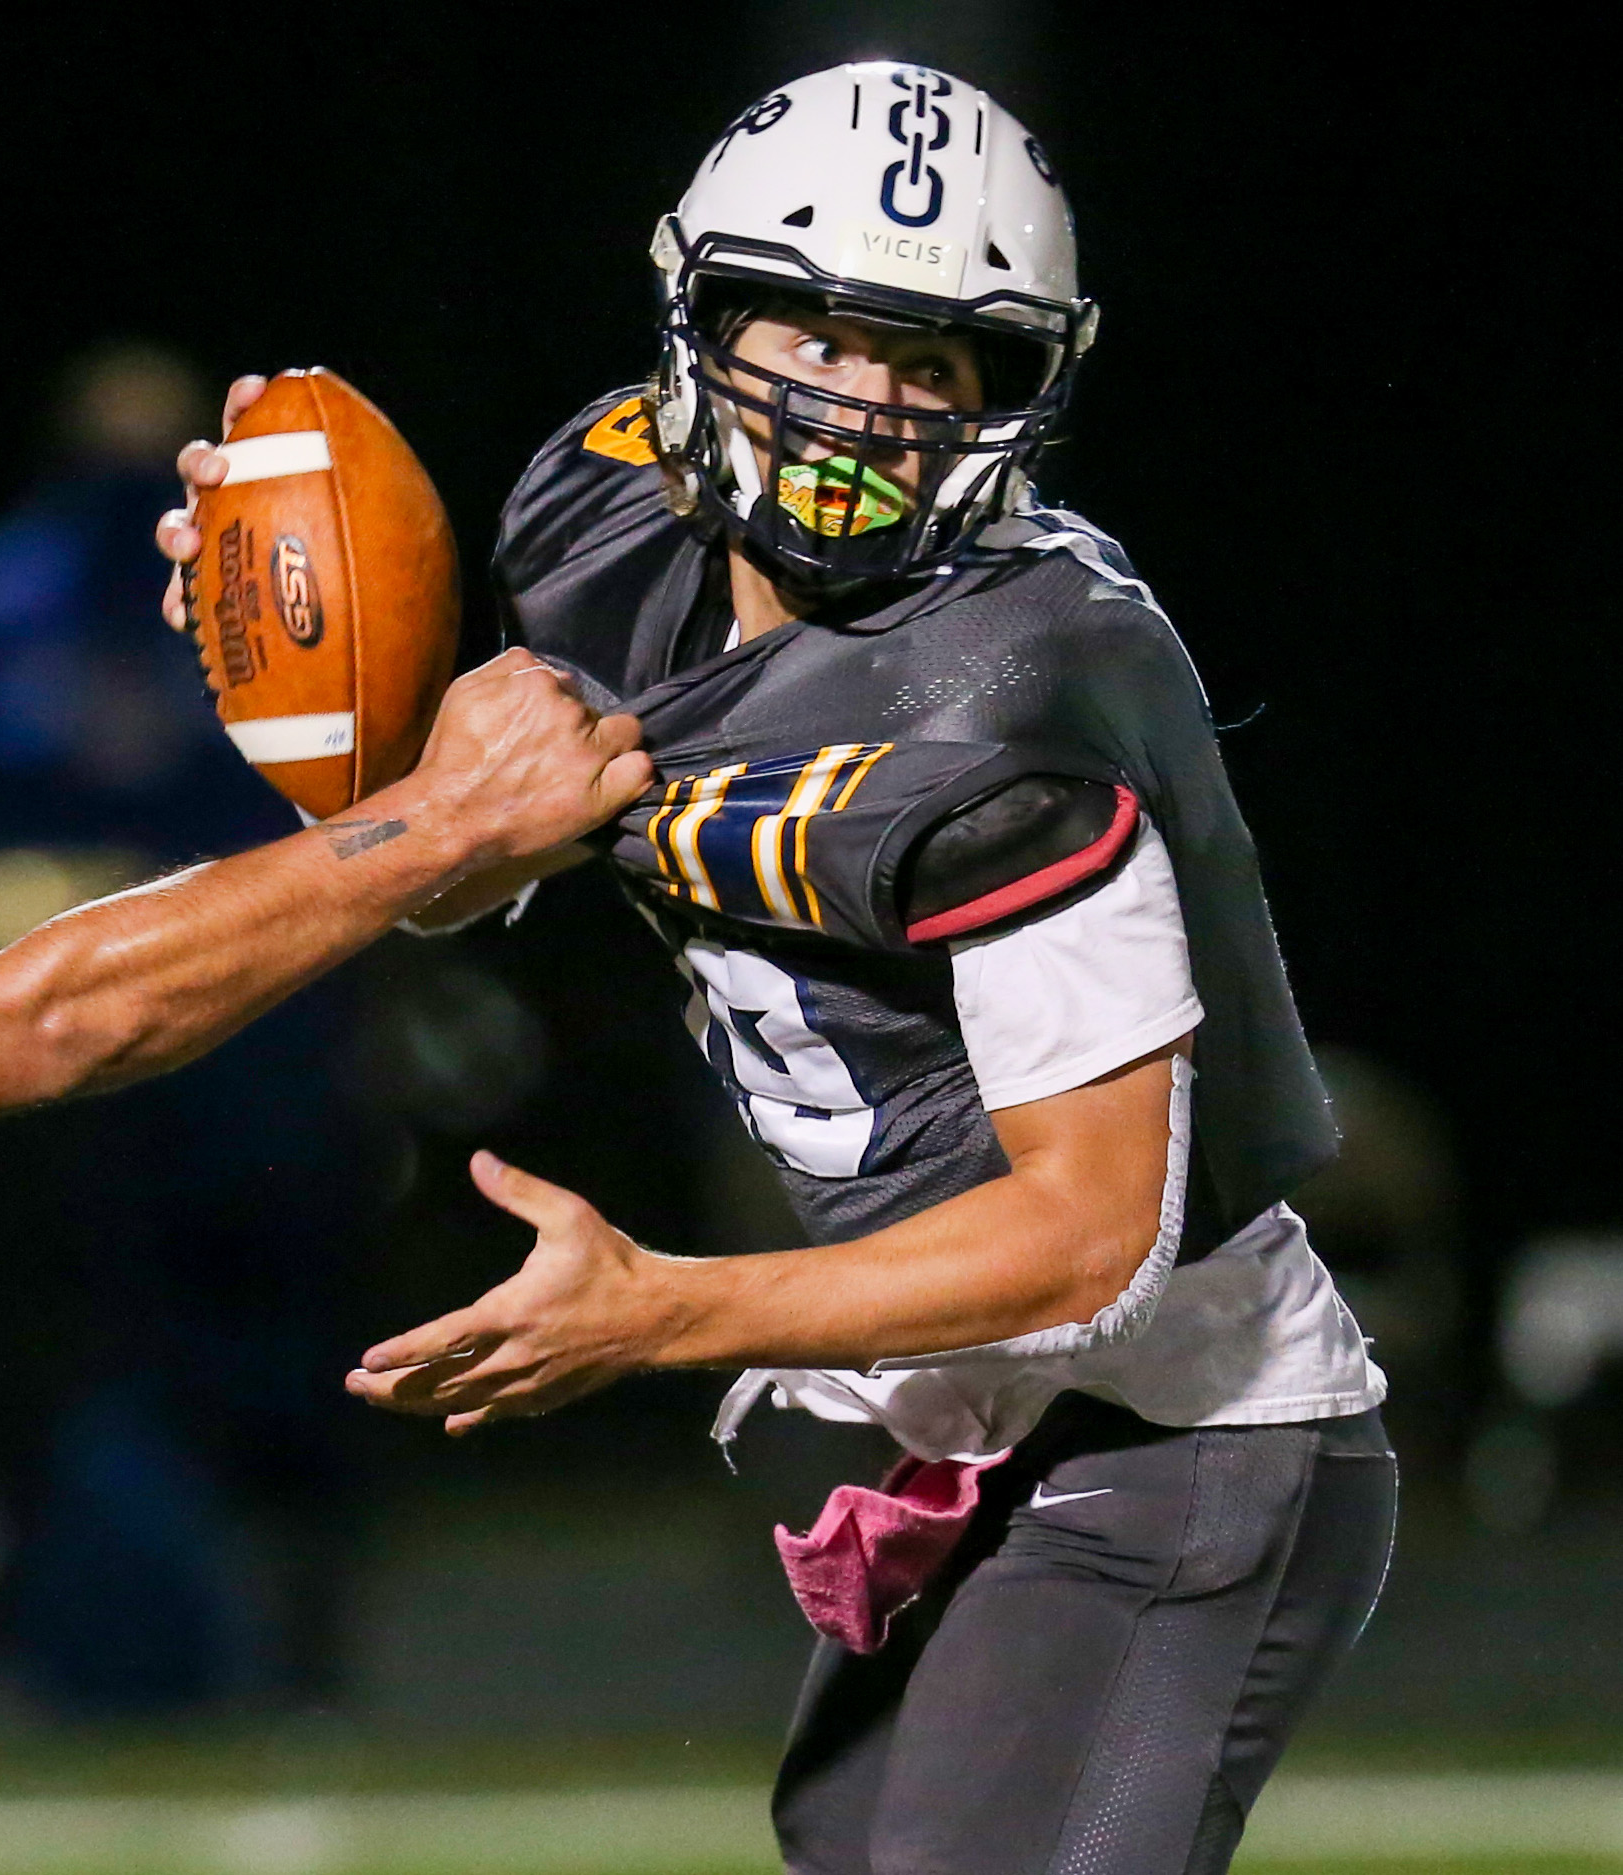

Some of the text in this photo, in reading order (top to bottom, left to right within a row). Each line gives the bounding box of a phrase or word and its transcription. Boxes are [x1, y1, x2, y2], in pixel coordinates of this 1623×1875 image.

[863, 231, 942, 264] VICIS
[215, 518, 255, 688] Wilson
[279, 541, 312, 639] GST
